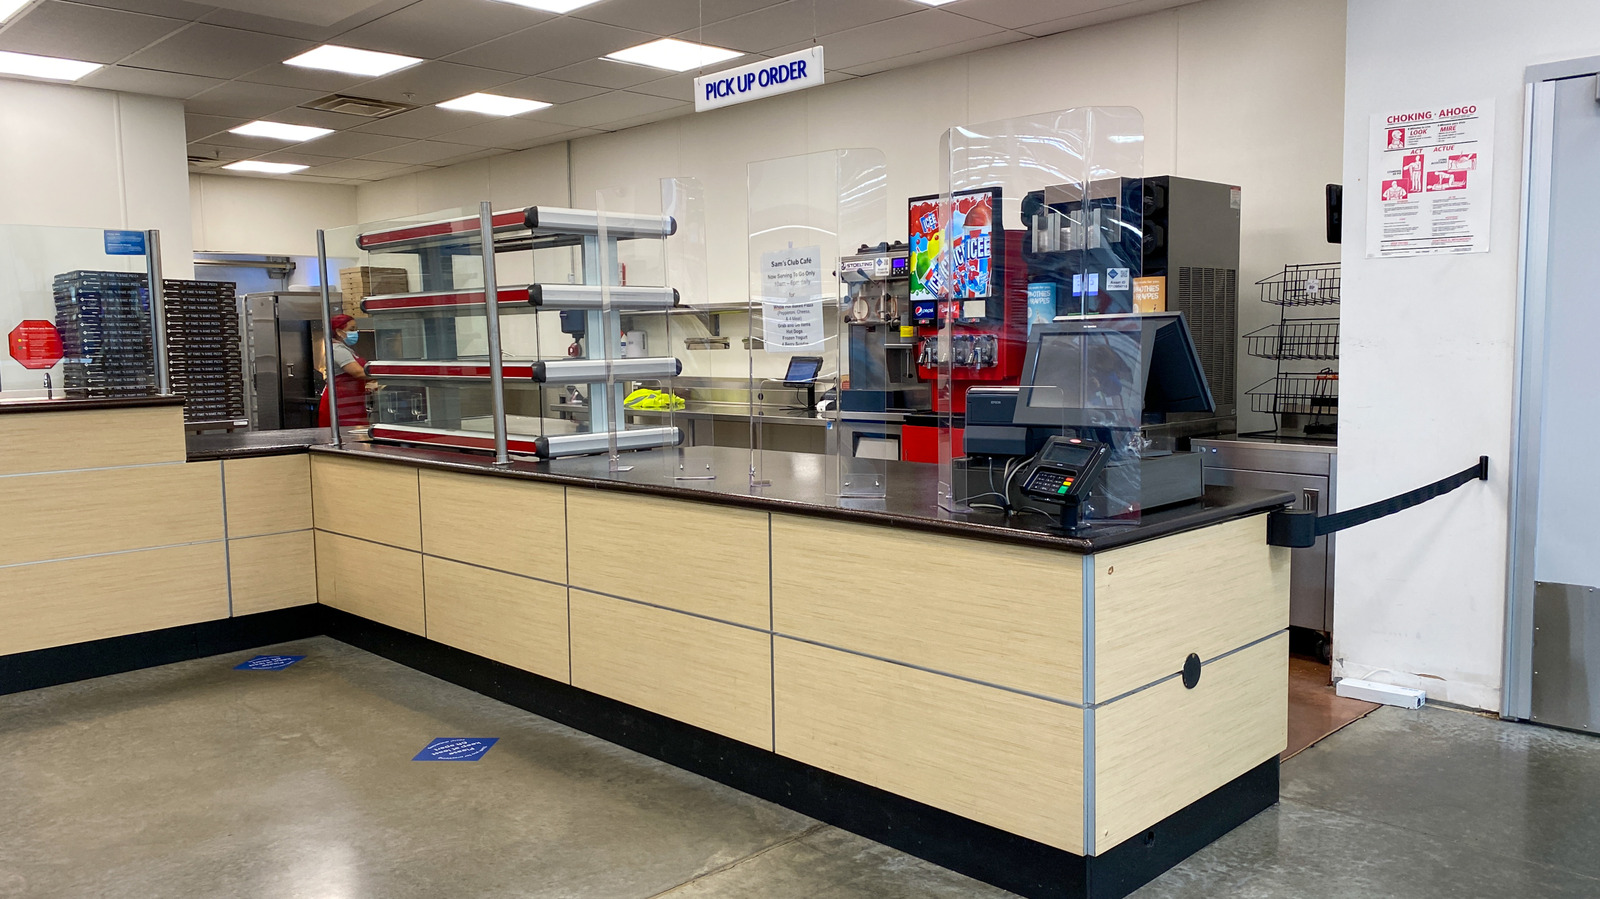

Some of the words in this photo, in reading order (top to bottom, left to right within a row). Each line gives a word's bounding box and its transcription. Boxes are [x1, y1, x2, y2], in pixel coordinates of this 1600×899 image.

[705, 77, 735, 100] PICK
[737, 72, 756, 92] UP
[758, 60, 807, 87] ORDER
[1386, 111, 1432, 124] CHOKING
[1439, 105, 1477, 117] AHOGO
[924, 214, 937, 231] ICEE
[967, 237, 990, 260] ICEE
